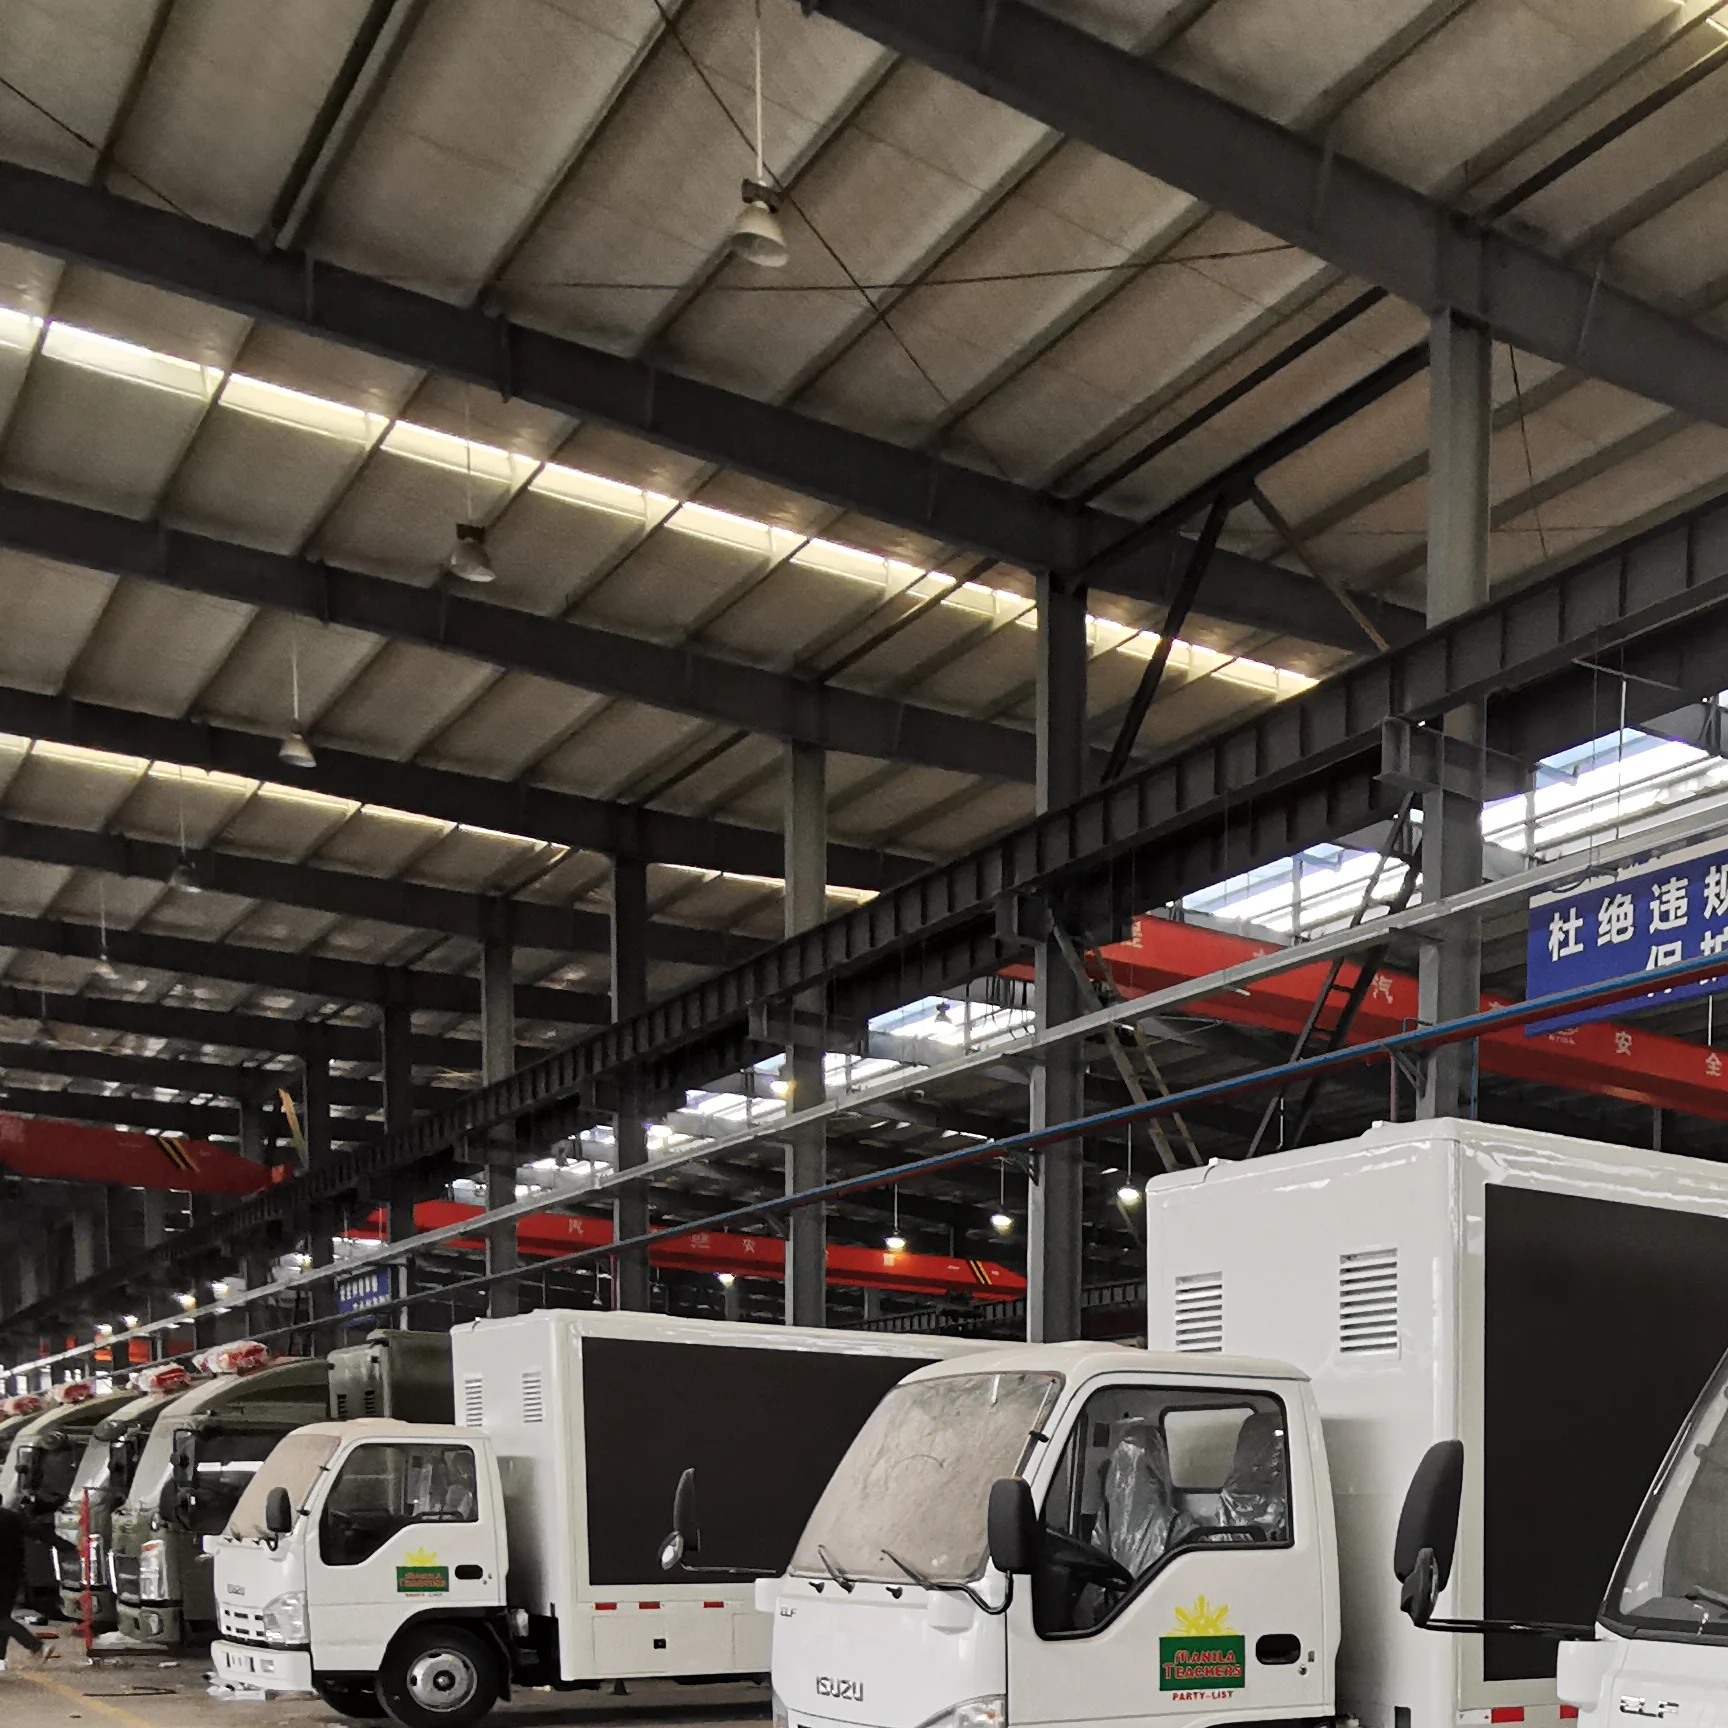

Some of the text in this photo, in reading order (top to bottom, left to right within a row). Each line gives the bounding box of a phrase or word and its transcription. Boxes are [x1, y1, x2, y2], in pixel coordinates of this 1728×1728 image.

[1174, 1649, 1236, 1665] MANILA
[1162, 1661, 1243, 1680] TEACHERS
[816, 1676, 864, 1702] ISUZU
[1172, 1690, 1234, 1701] PARTY-LIST
